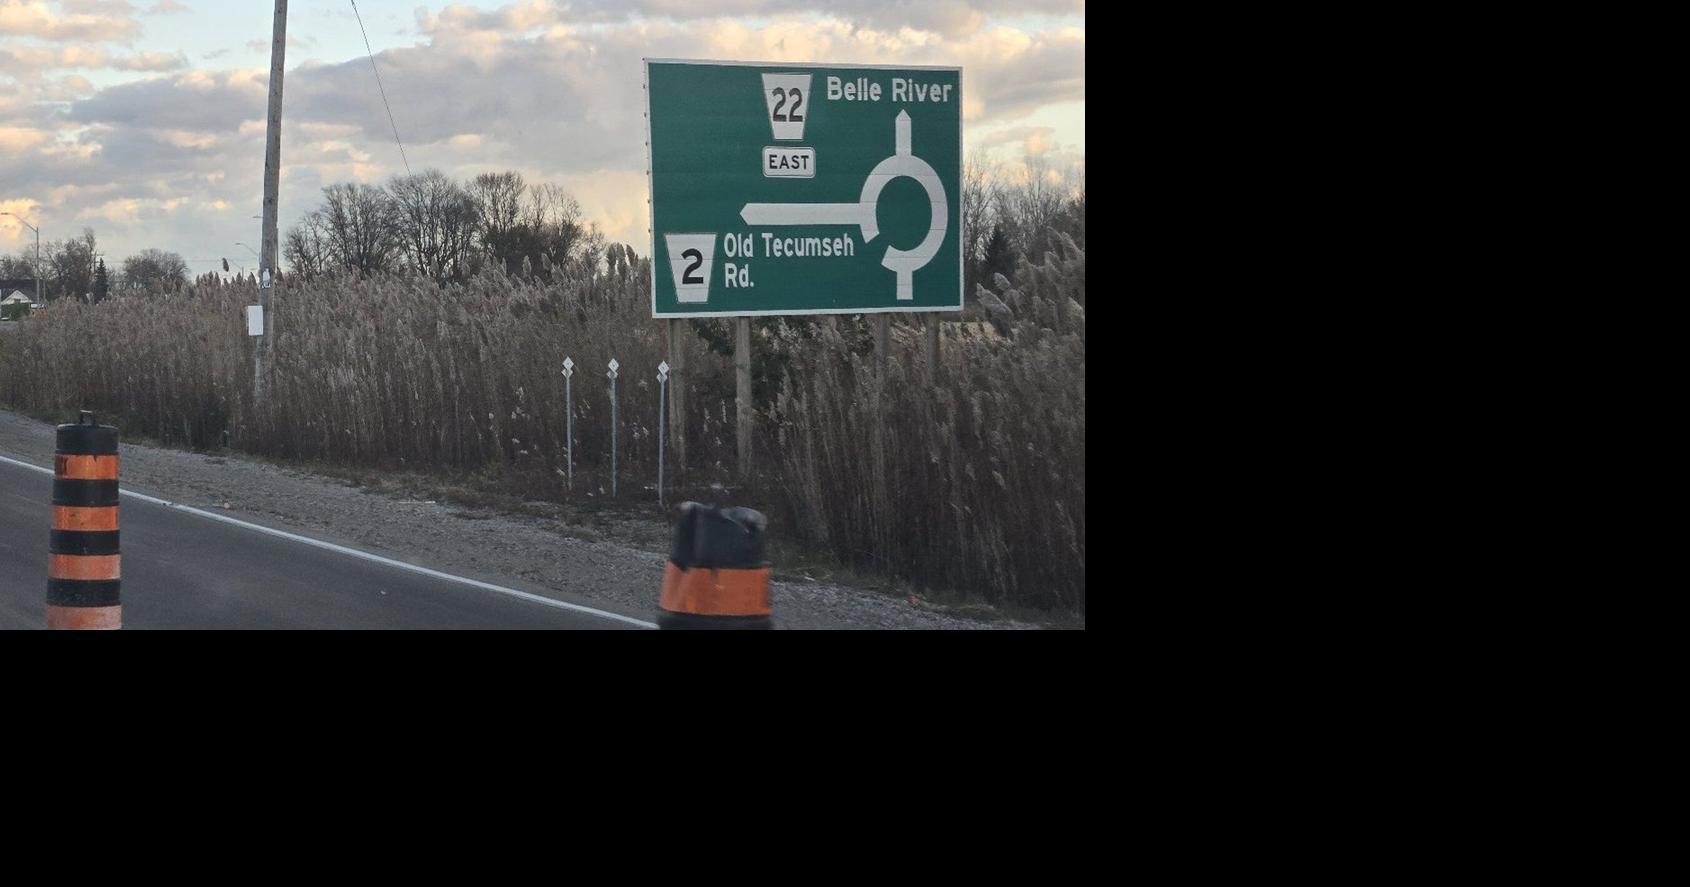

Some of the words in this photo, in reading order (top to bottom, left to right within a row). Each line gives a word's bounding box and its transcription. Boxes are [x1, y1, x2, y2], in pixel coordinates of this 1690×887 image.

[827, 76, 882, 101] Belle
[892, 78, 952, 102] River
[772, 87, 804, 122] 22
[769, 154, 809, 169] EAST
[724, 233, 753, 258] Old
[762, 233, 854, 257] Tecumseh
[681, 248, 704, 285] 2
[725, 263, 754, 288] Rd.
